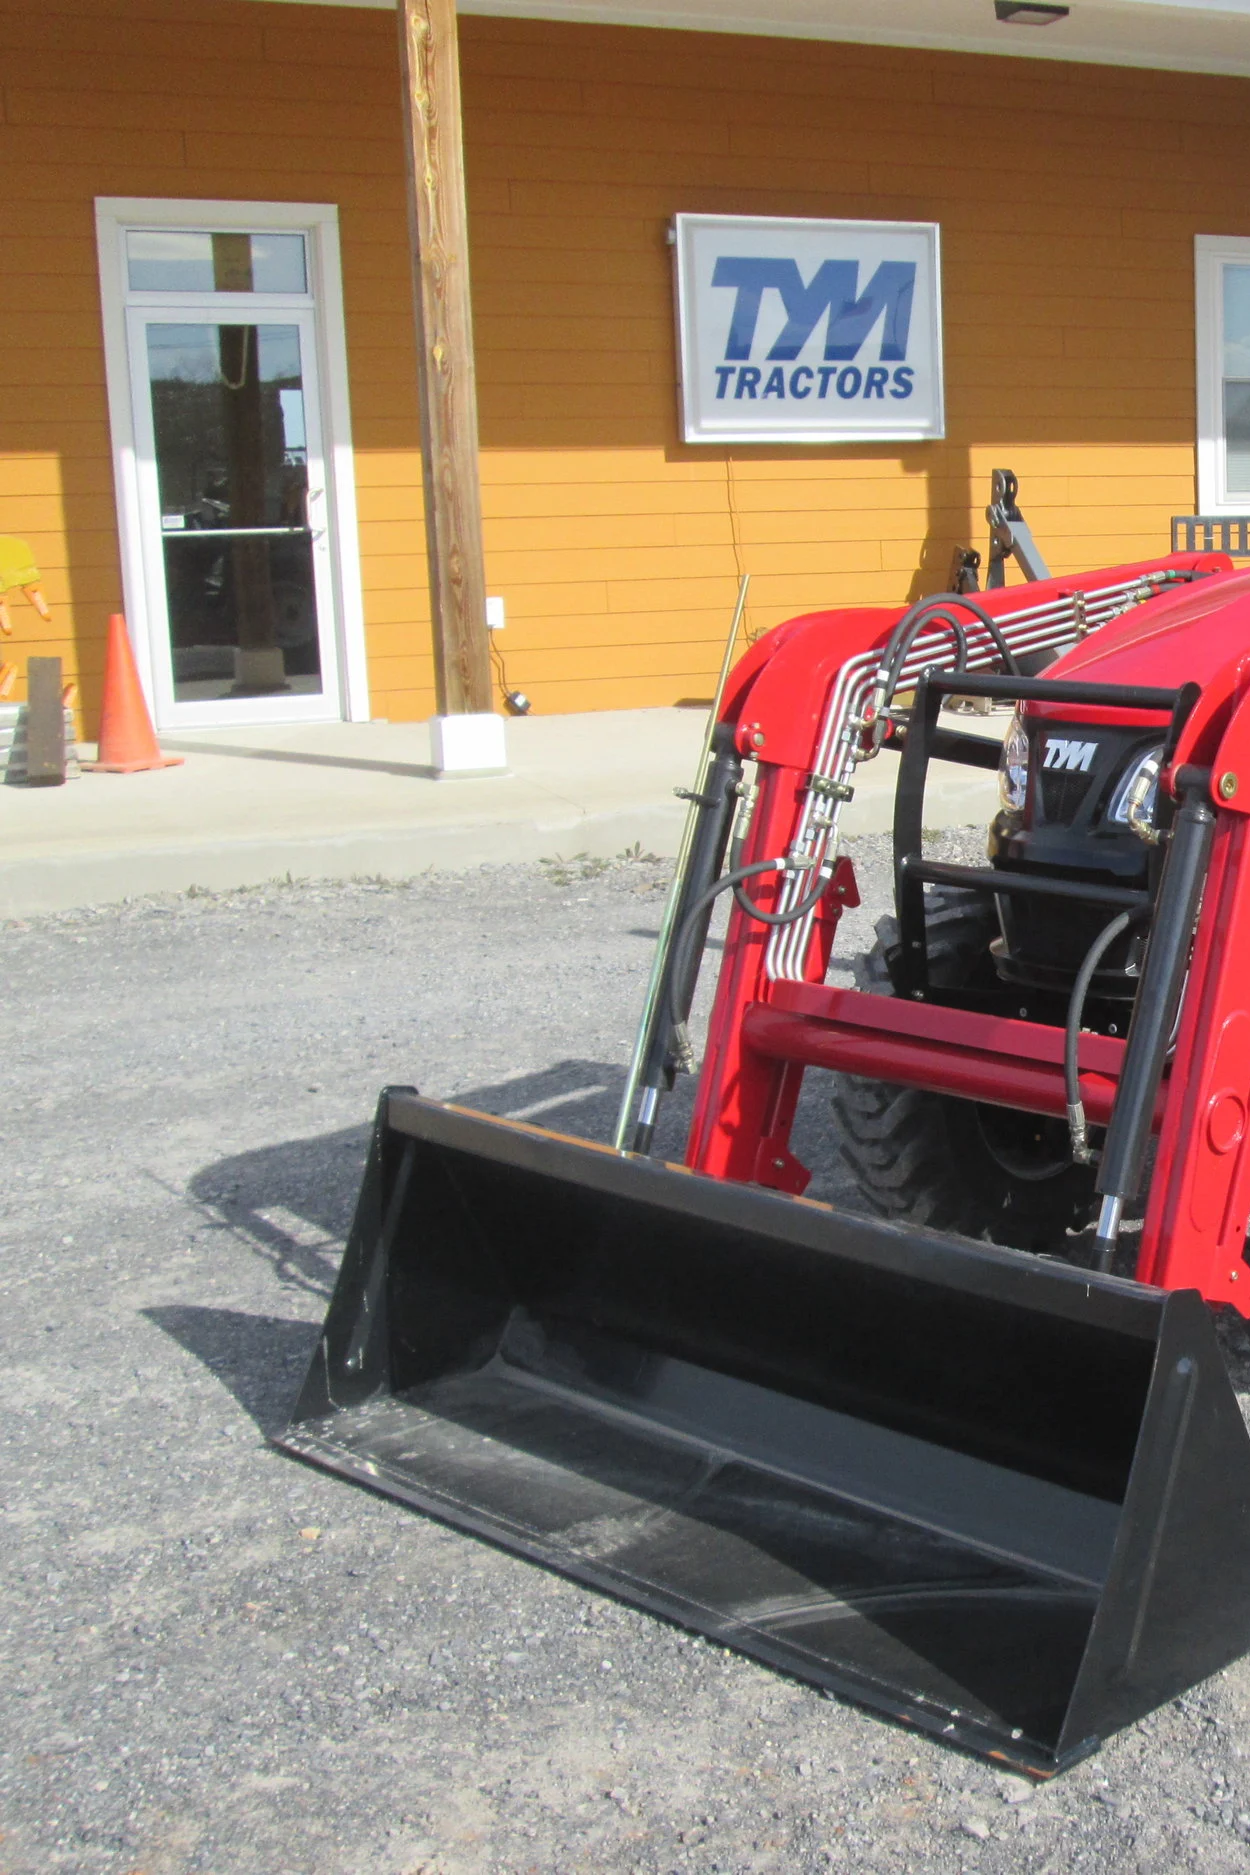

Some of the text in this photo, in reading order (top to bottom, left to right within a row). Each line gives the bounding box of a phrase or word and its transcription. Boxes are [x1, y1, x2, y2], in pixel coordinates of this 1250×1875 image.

[711, 256, 917, 361] TYM
[714, 366, 915, 399] TRACTORS
[1043, 738, 1099, 772] TYM
